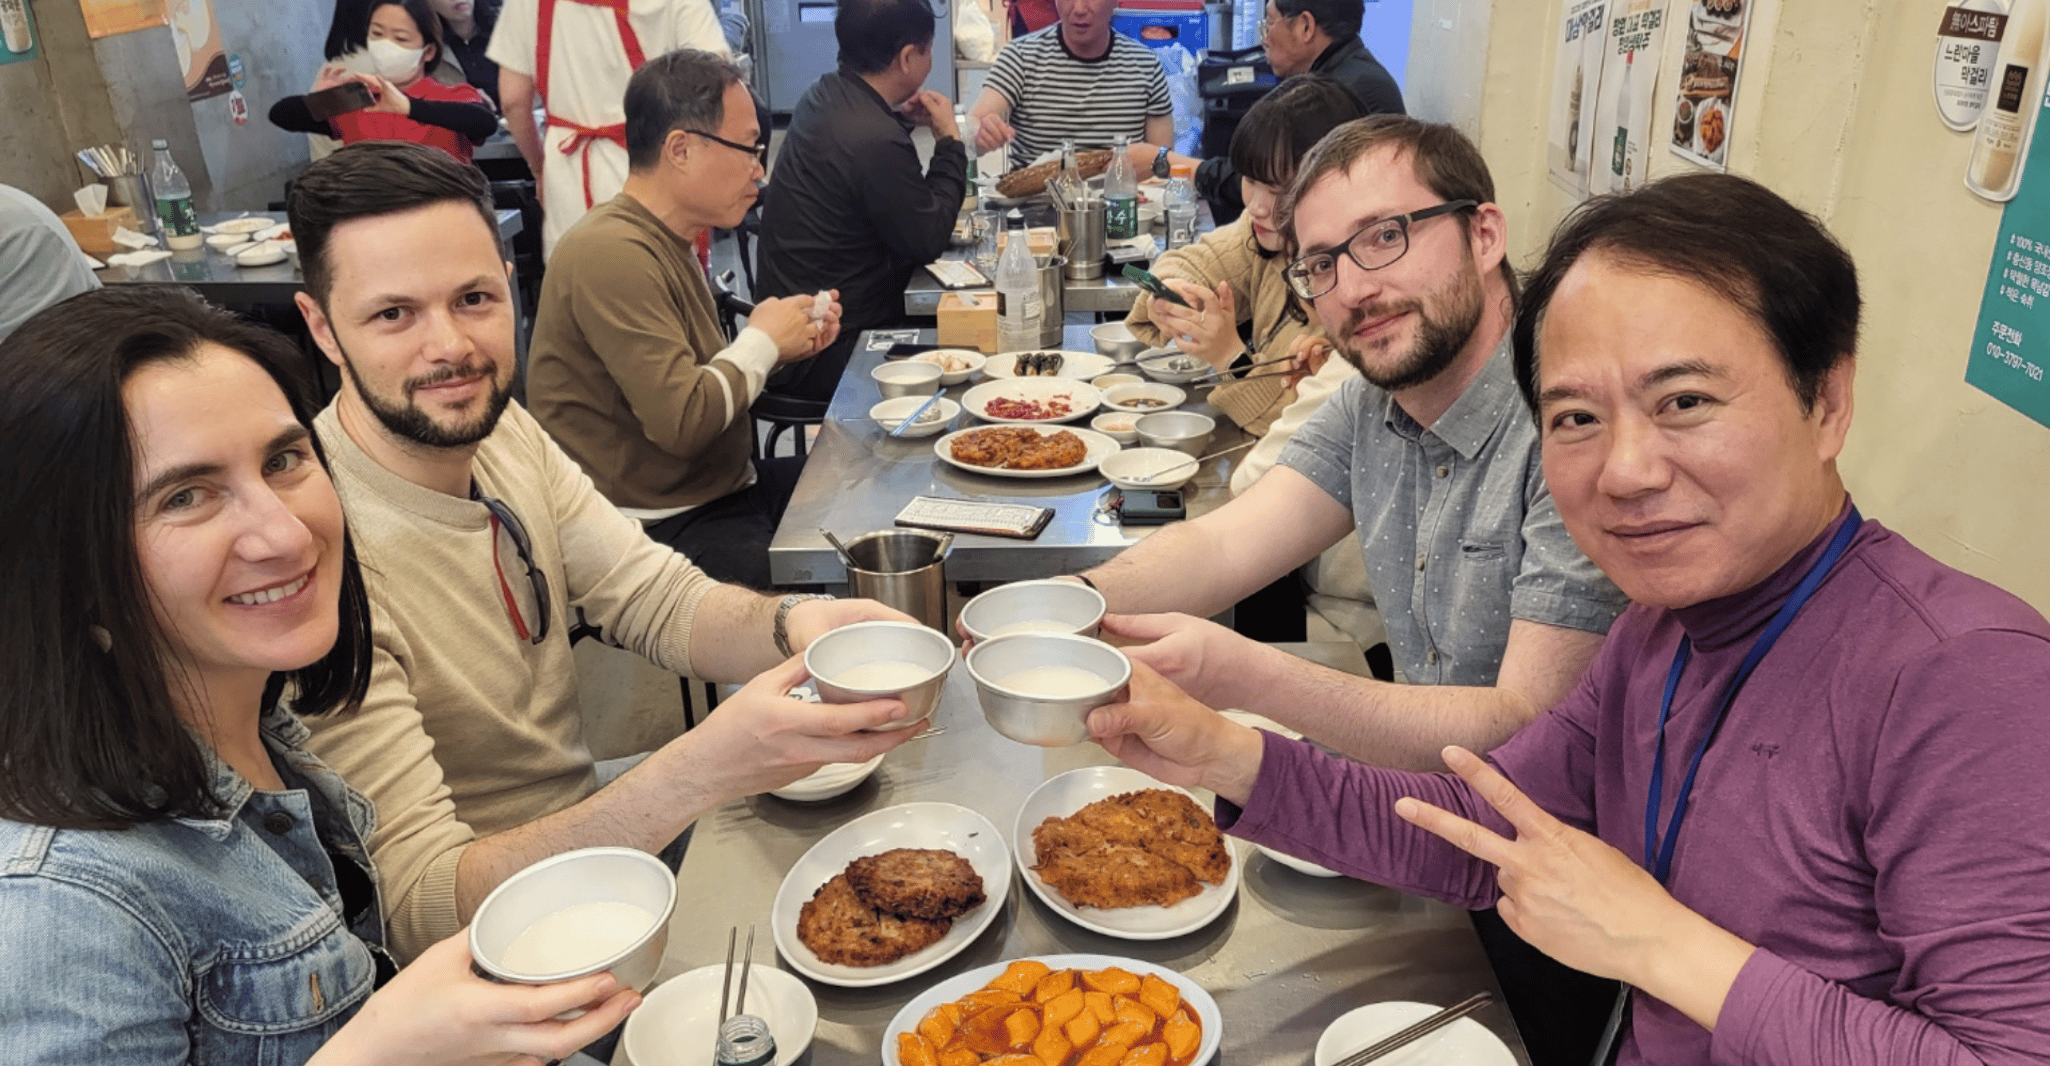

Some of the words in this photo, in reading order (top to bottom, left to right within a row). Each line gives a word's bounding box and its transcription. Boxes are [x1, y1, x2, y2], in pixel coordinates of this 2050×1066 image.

[1944, 44, 1980, 64] 느린마을
[1961, 66, 1988, 86] 막걸리
[1992, 321, 2023, 347] 주문전화
[1987, 342, 2043, 381] 010-3797-7021
